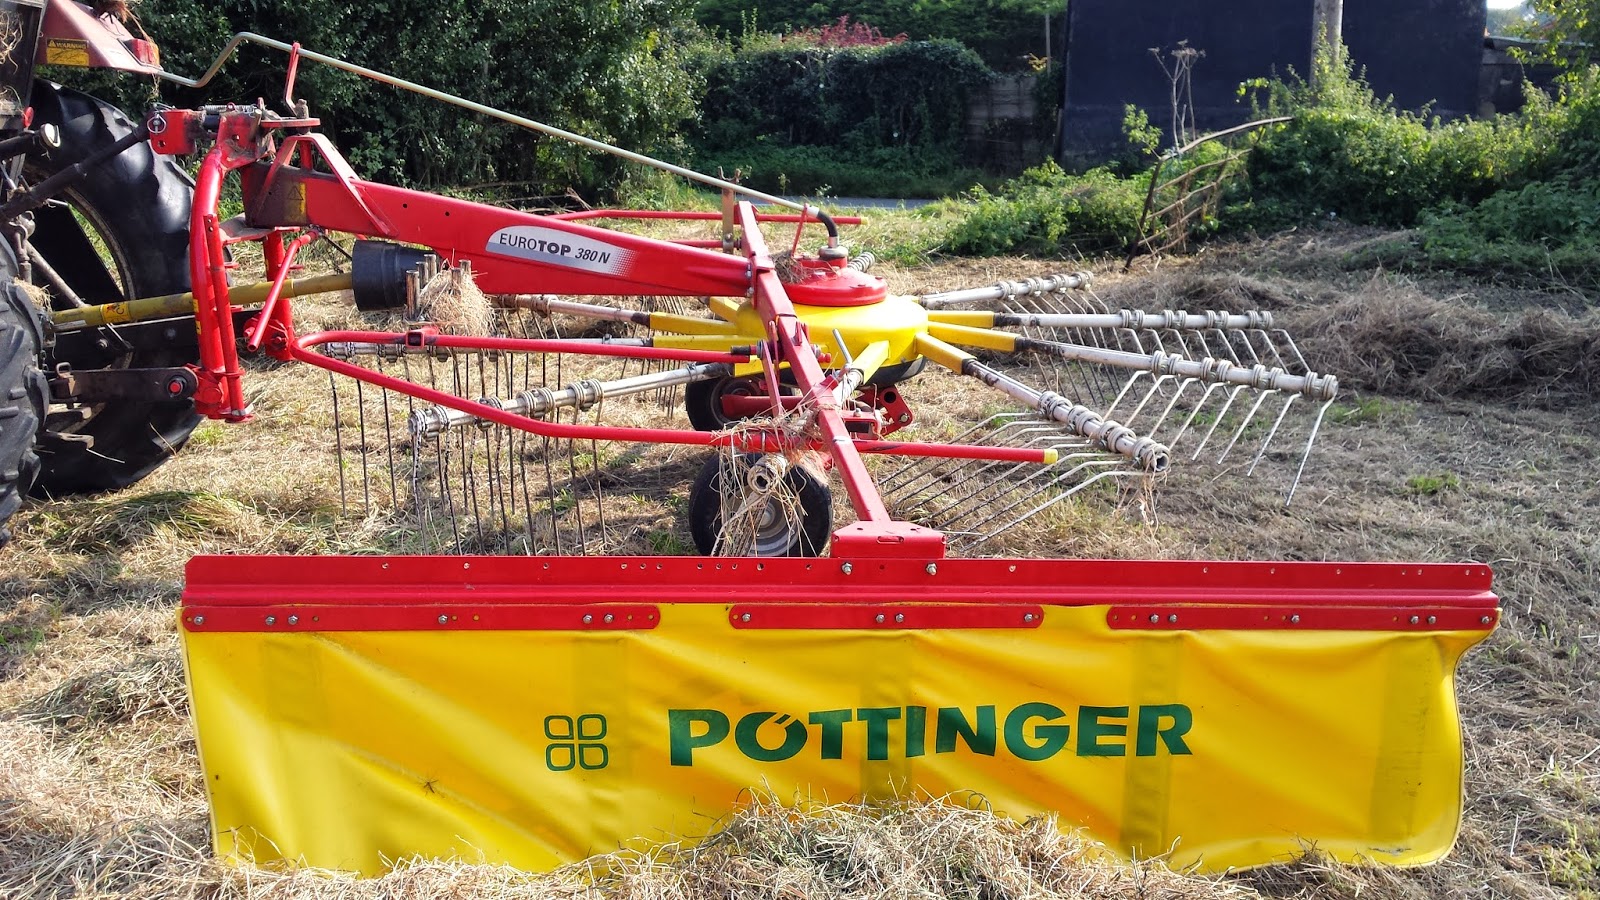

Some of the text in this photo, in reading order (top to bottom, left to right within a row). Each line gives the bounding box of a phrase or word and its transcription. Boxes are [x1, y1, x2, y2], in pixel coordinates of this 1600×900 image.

[500, 233, 611, 264] EUROTOP 380 N
